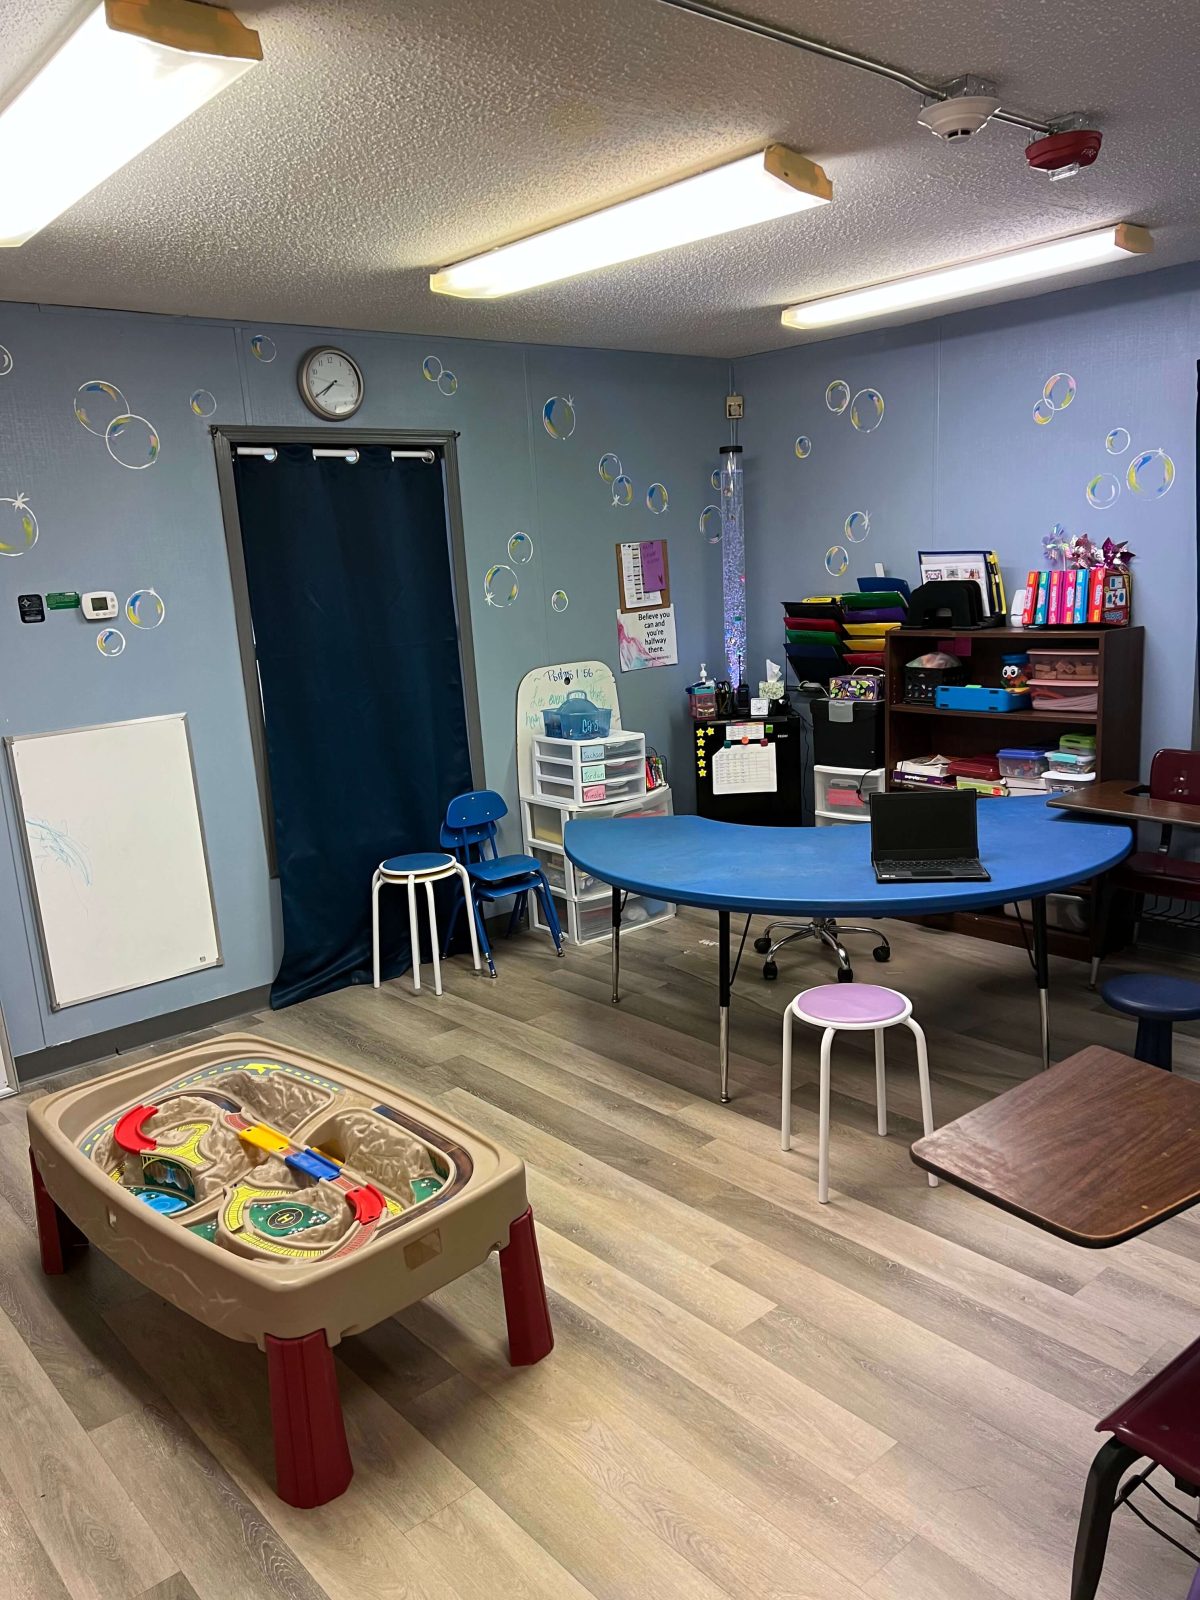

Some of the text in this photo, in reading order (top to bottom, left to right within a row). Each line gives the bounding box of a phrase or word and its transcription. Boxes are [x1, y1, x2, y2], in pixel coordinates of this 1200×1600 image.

[638, 612, 670, 621] Believe you
[644, 621, 654, 629] can
[646, 628, 664, 638] you're
[644, 637, 667, 646] halfway
[648, 646, 665, 654] there.
[278, 1214, 293, 1223] H
